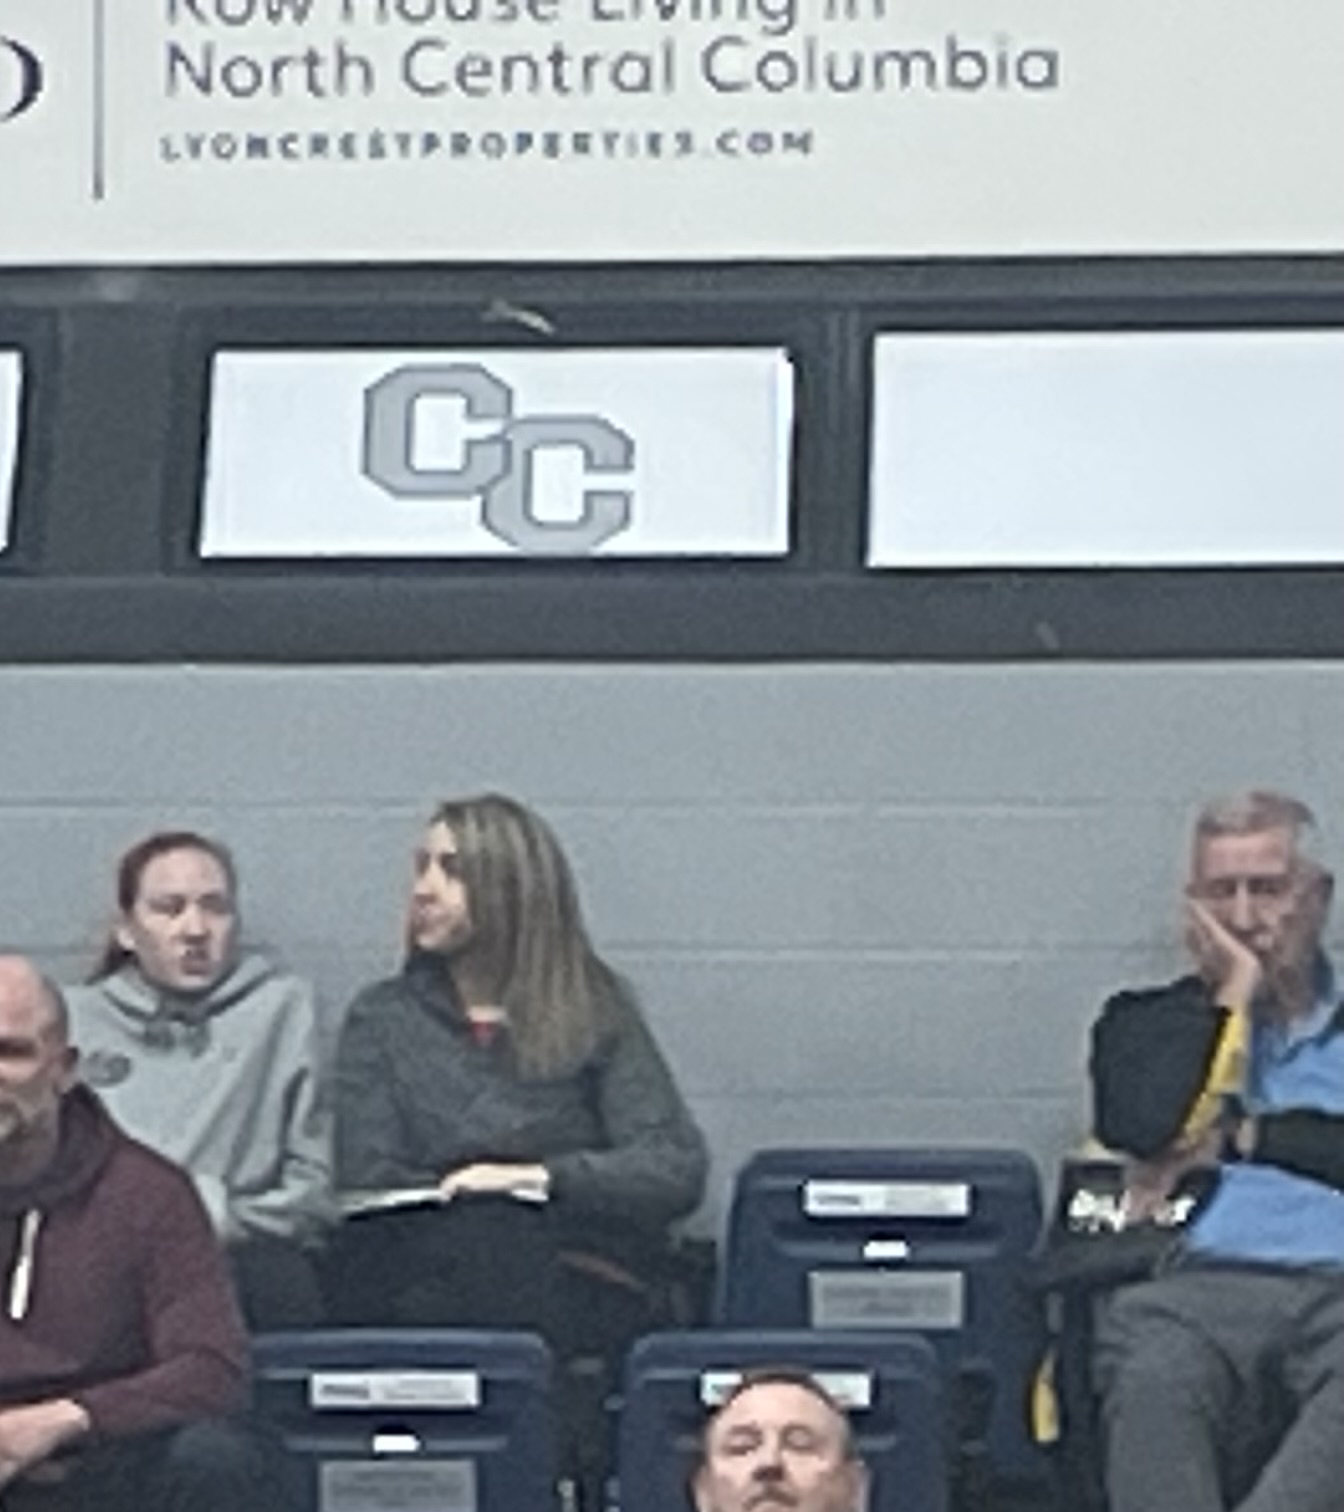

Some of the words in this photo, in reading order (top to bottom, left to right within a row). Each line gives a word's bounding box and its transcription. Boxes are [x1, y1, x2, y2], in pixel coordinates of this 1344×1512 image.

[165, 39, 374, 98] North
[401, 36, 674, 97] Central
[702, 33, 1060, 94] Columbia
